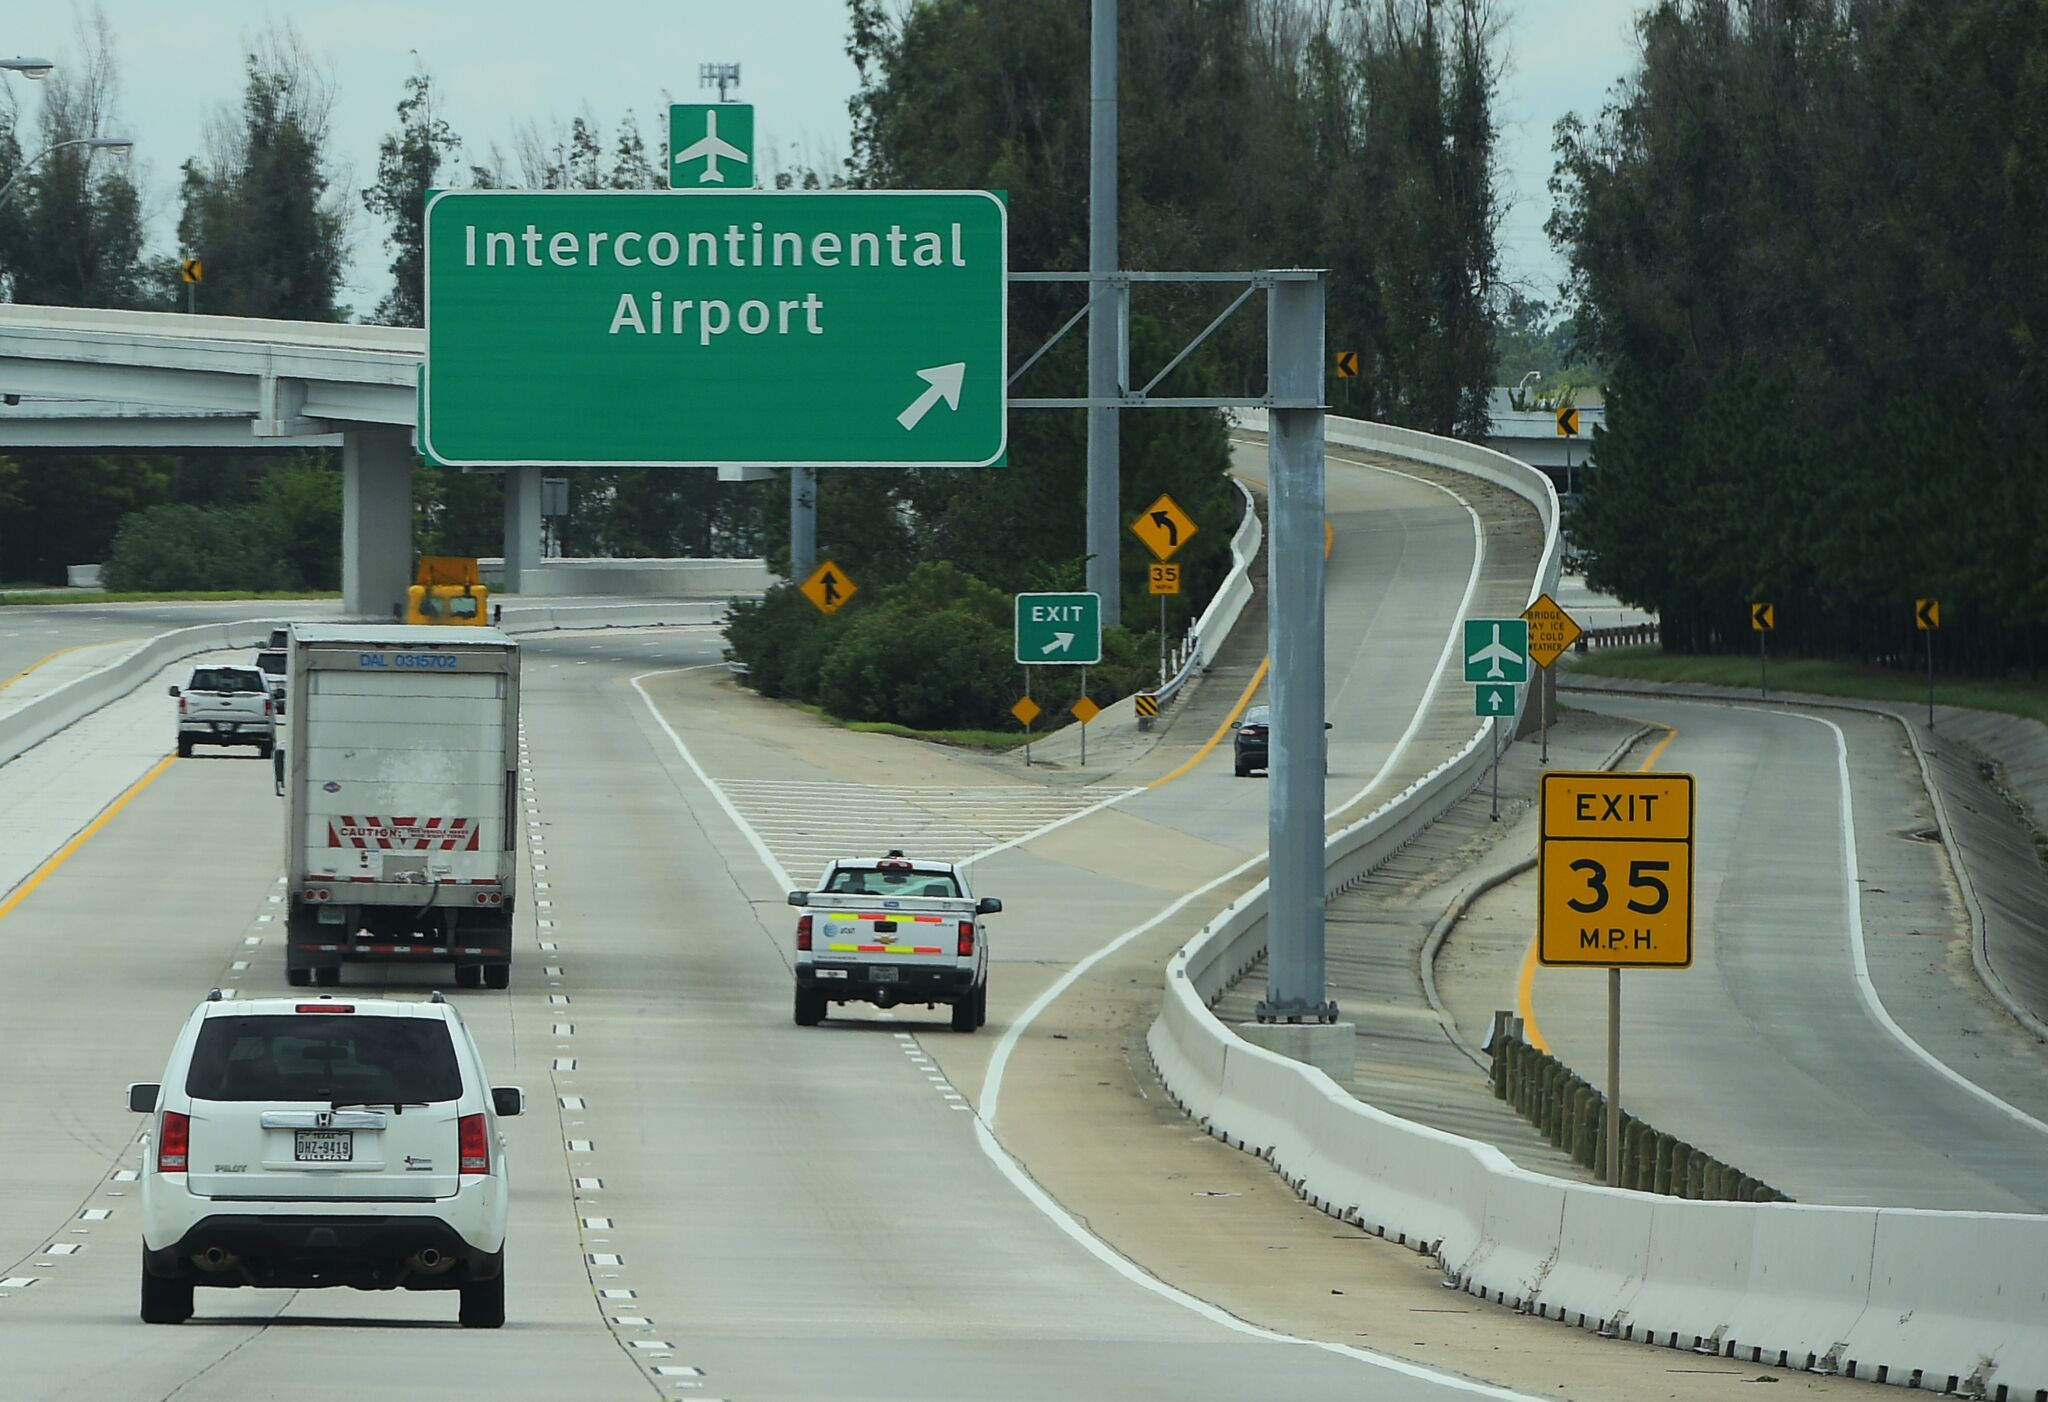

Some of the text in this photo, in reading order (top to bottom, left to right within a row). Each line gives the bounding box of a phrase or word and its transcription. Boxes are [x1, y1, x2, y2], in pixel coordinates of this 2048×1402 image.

[465, 222, 965, 267] Intercontinental
[609, 291, 824, 346] Airport
[1152, 567, 1177, 582] 35
[1032, 606, 1084, 622] EXIT
[1528, 611, 1562, 620] BRIDGE
[1550, 621, 1565, 631] ICE
[1540, 632, 1564, 641] COLD
[360, 654, 457, 668] DAL 0315702
[1577, 793, 1659, 822] EXIT
[1567, 858, 1670, 915] 35
[1580, 928, 1658, 949] M.P.H.
